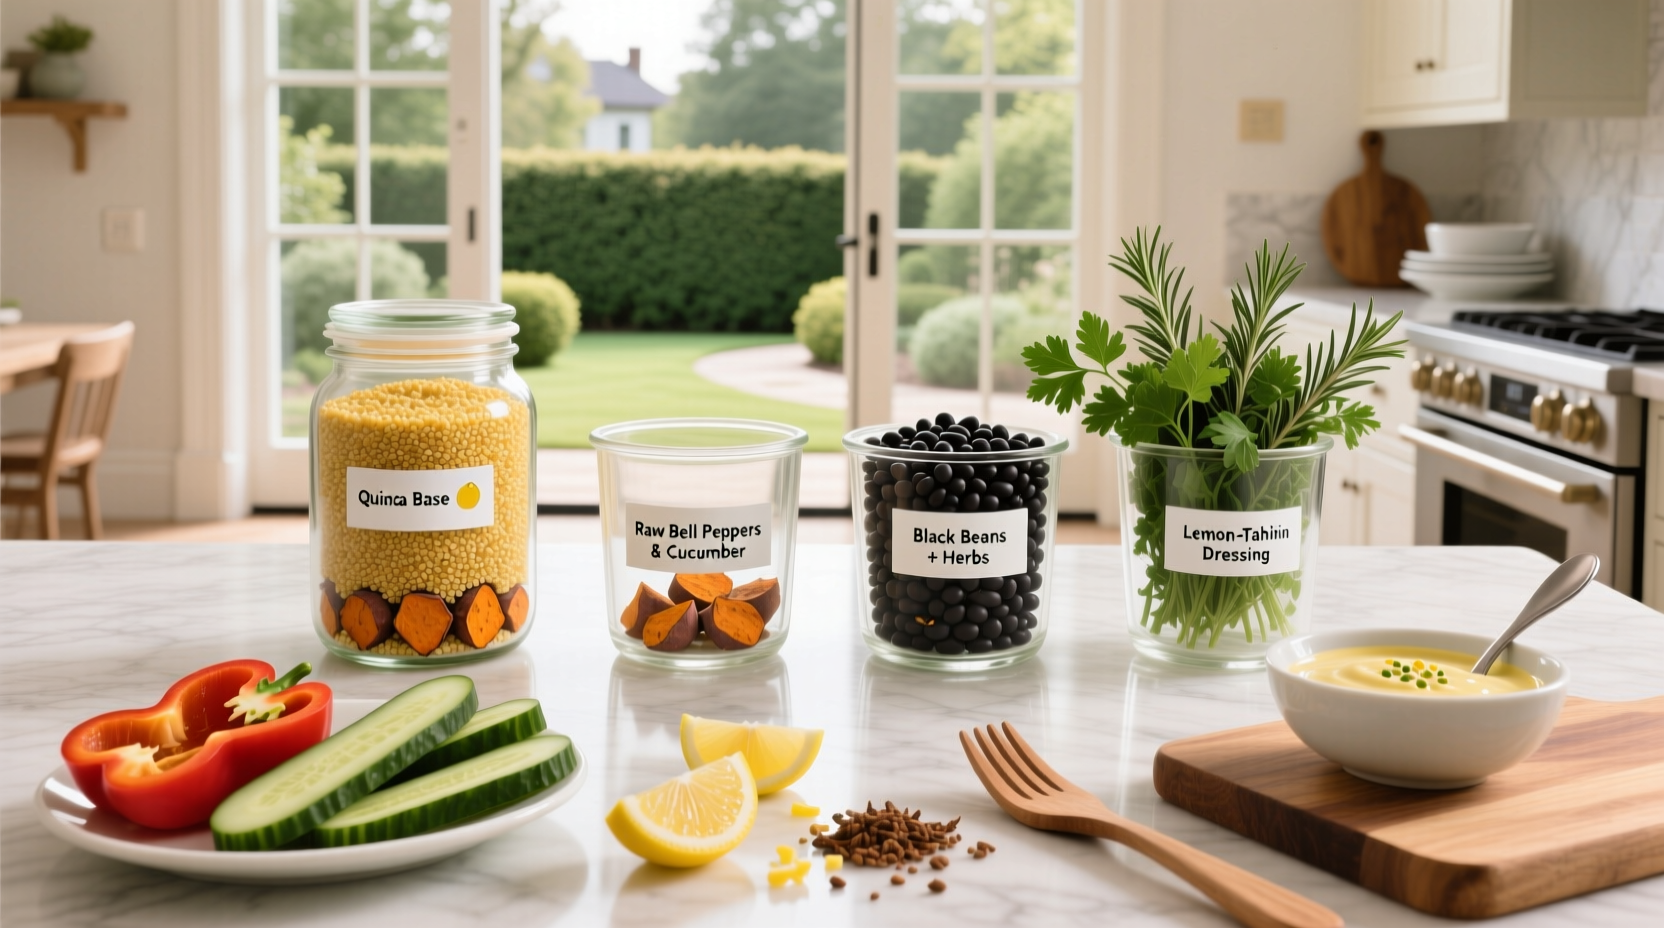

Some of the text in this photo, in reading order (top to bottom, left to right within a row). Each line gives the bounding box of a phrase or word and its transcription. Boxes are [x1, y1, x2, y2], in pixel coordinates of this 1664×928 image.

[412, 491, 450, 507] Base
[635, 520, 762, 542] Raw Bell Peppers
[913, 527, 1007, 545] Black Beans
[650, 542, 746, 560] & Cucumber
[927, 549, 990, 566] + Herbs
[1202, 545, 1270, 565] Dressing
